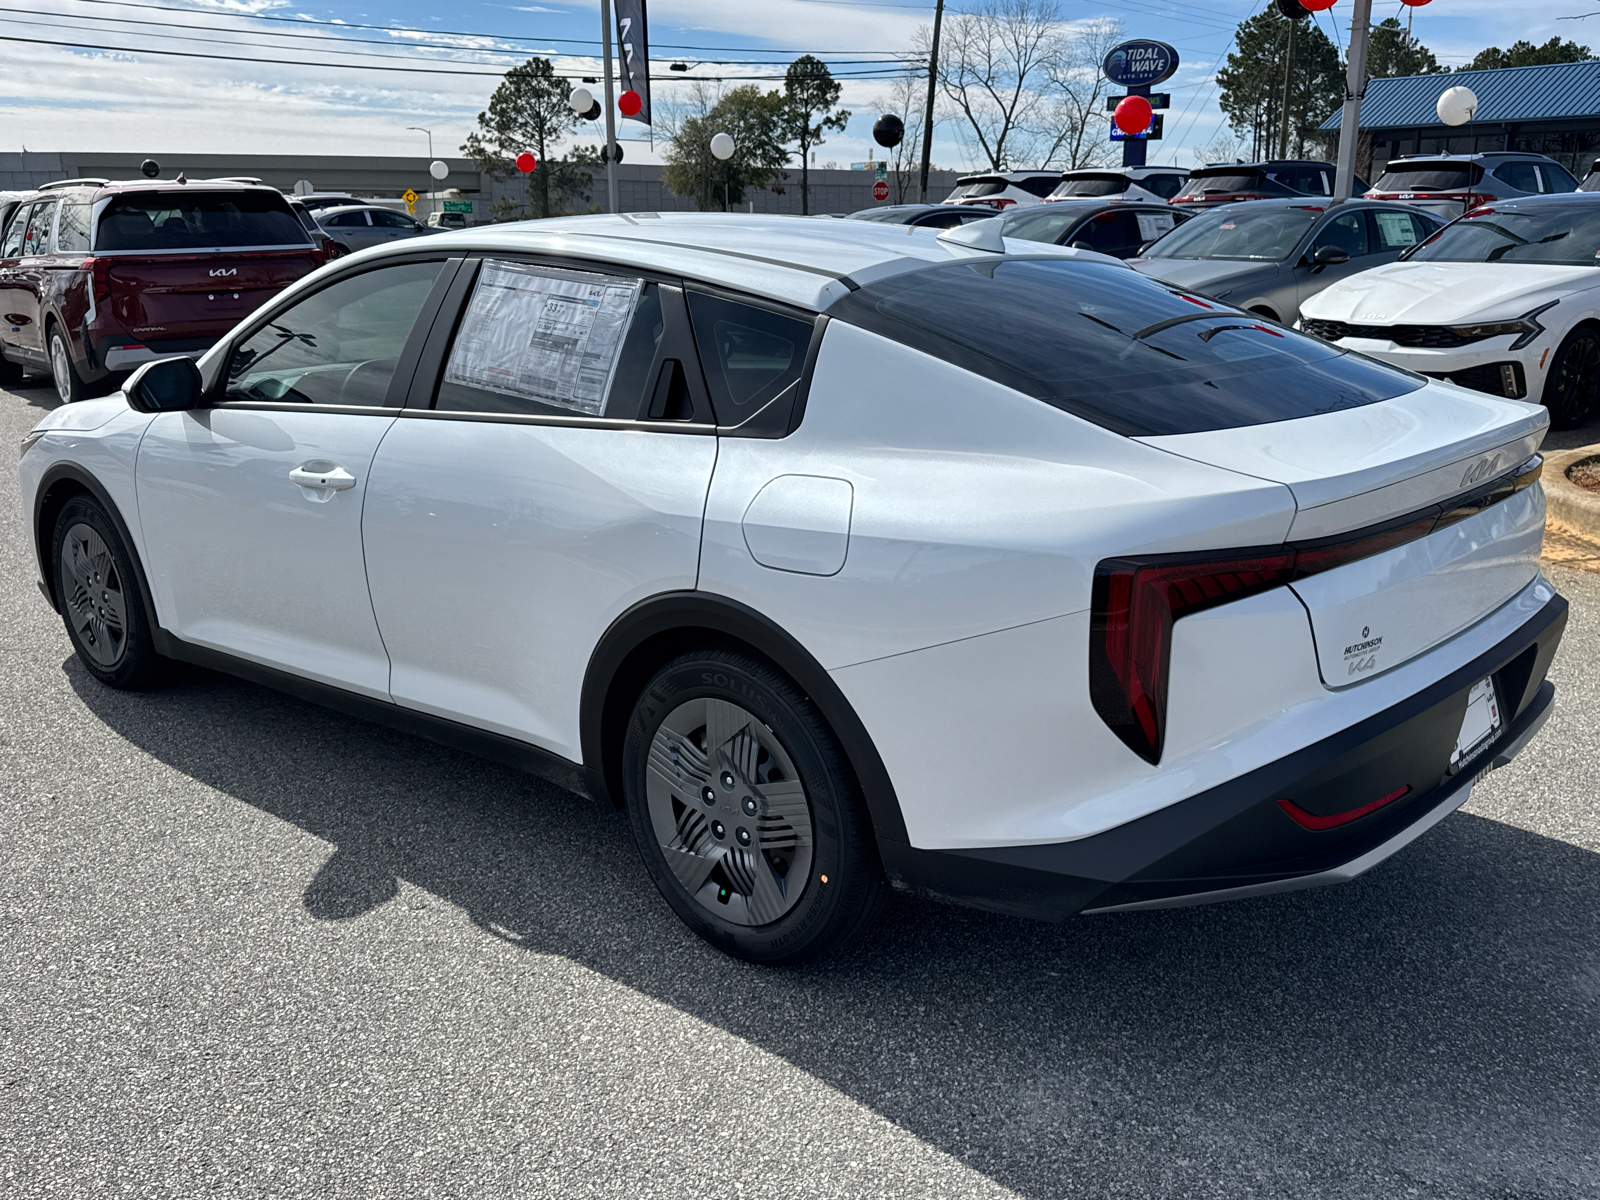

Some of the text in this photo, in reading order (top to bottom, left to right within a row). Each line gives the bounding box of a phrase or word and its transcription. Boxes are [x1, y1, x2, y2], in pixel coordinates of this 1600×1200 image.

[1127, 48, 1158, 60] TIDAL
[1131, 60, 1165, 72] WAVE
[874, 187, 888, 195] STOP
[209, 268, 237, 277] KIA
[1459, 453, 1501, 488] KIA
[1344, 636, 1383, 655] HUTCHINSON
[1348, 655, 1375, 675] K4
[701, 672, 768, 711] SOLUS
[770, 934, 790, 949] 91H
